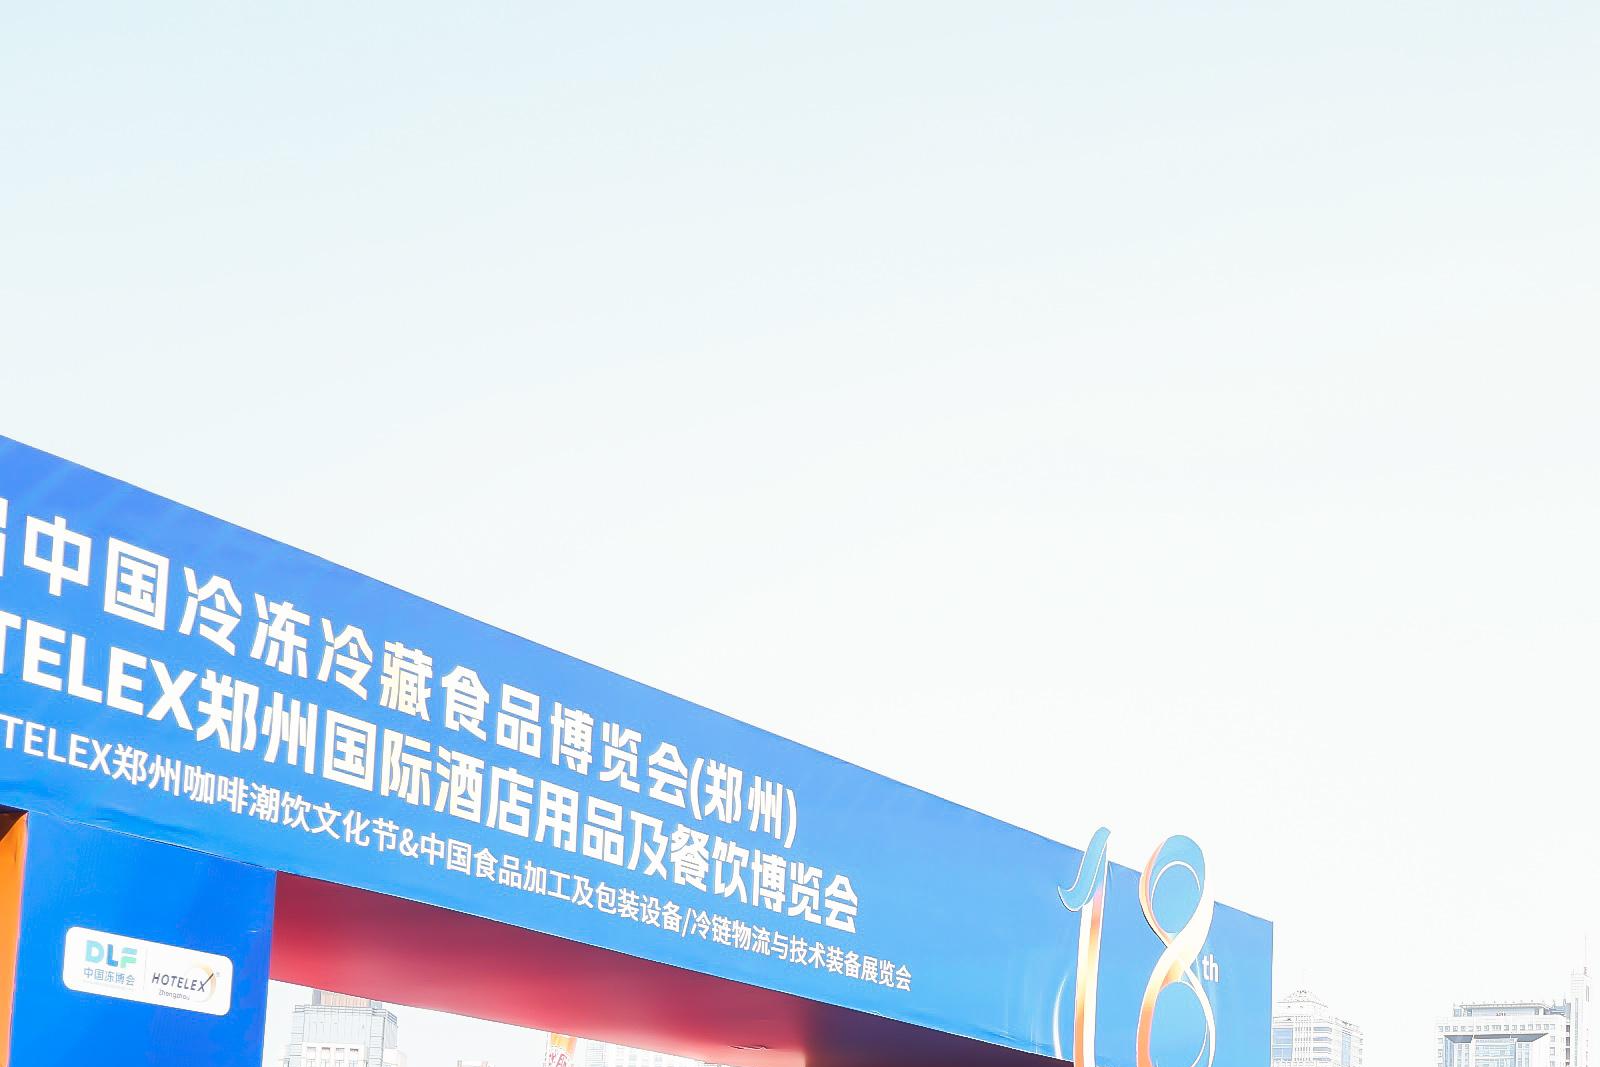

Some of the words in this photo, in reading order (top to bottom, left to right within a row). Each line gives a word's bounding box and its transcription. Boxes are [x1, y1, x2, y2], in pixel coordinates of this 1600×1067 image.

[0, 497, 796, 849] 中国冷冻冷藏食品博览会(郑州)
[85, 940, 138, 968] DLF
[84, 967, 136, 986] 中国冻博会
[152, 972, 214, 992] HOTELEX
